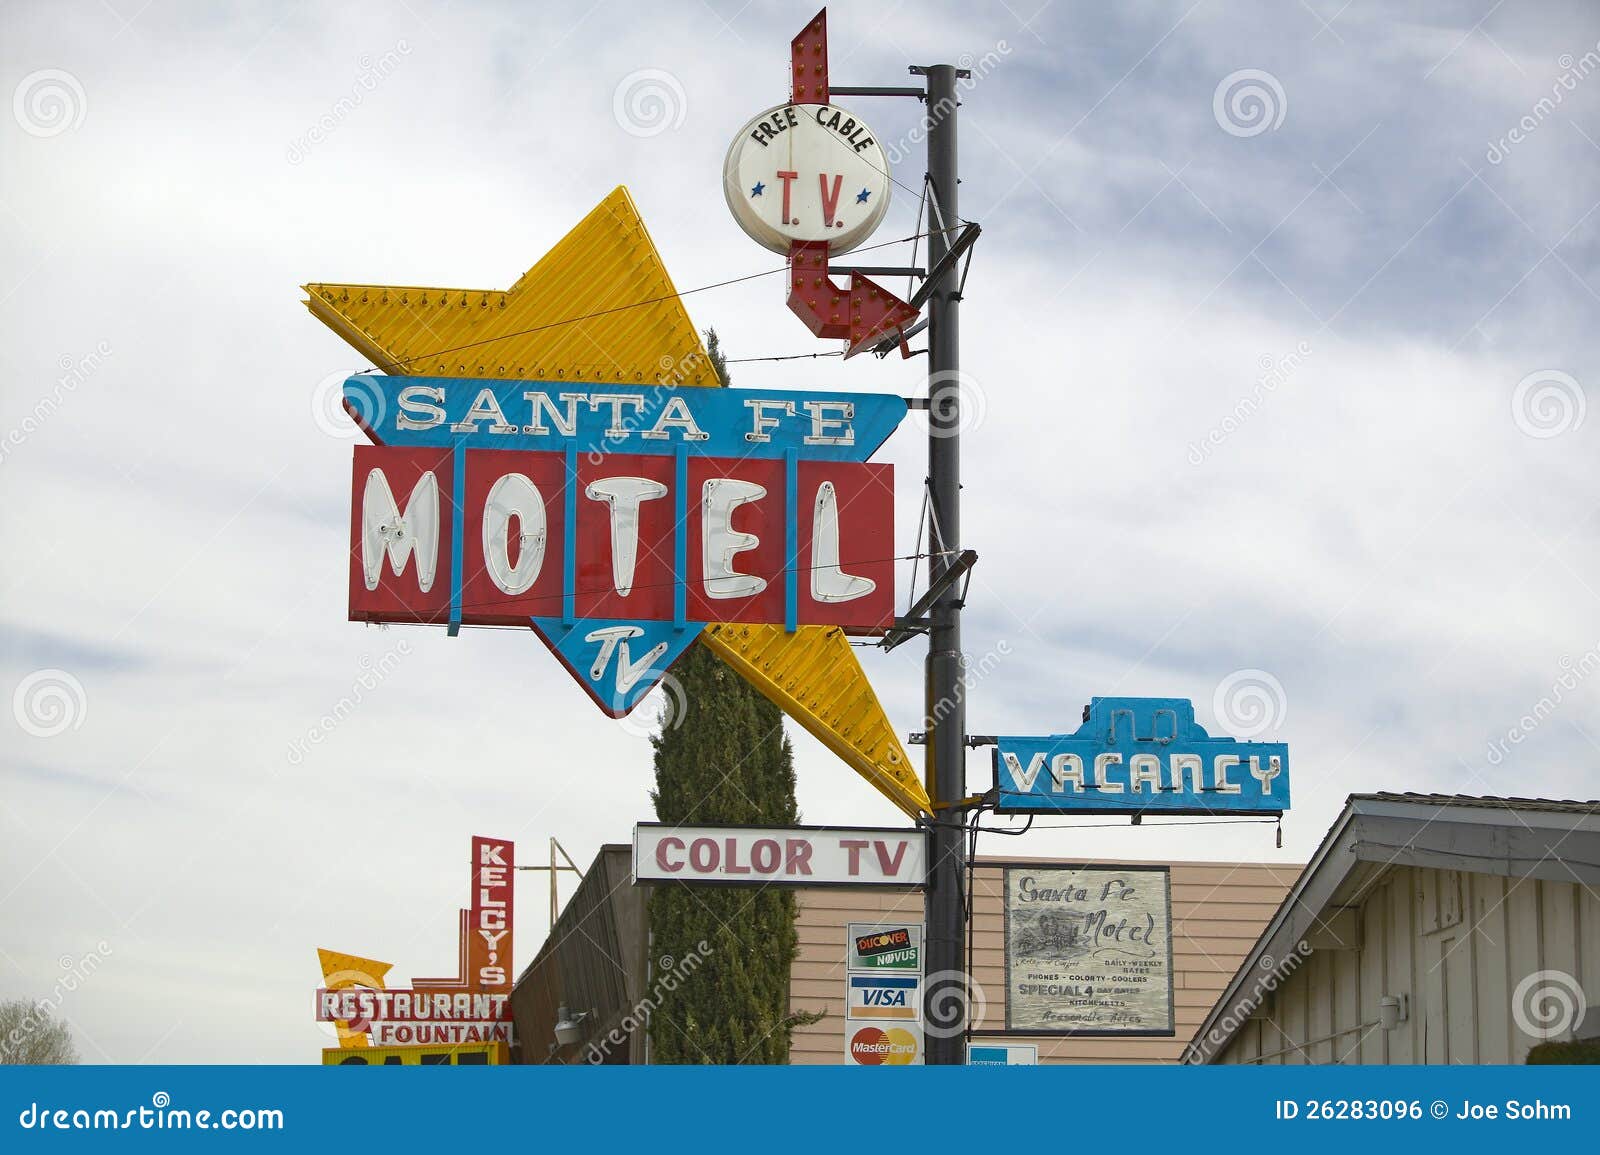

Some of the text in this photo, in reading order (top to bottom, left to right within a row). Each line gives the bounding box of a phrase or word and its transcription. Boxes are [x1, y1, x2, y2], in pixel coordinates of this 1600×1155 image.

[750, 106, 875, 153] FREE CABLE
[396, 385, 856, 446] SANTA FE
[362, 467, 877, 603] MOTEL
[585, 626, 668, 694] TV
[1002, 752, 1282, 795] VACANCY
[655, 836, 909, 877] COLOR TV
[1017, 876, 1138, 903] Santa Fe
[478, 844, 509, 986] KELCY'S
[1082, 909, 1155, 948] Motel
[858, 932, 907, 950] DISCOVER
[877, 949, 916, 966] NOVUS
[1018, 983, 1083, 996] SPECIAL
[1027, 973, 1059, 981] PHONES
[321, 992, 509, 1020] RESTAURANT
[863, 989, 906, 1006] VISA
[381, 1025, 508, 1043] FOUNTAIN
[853, 1042, 915, 1053] MasterCard
